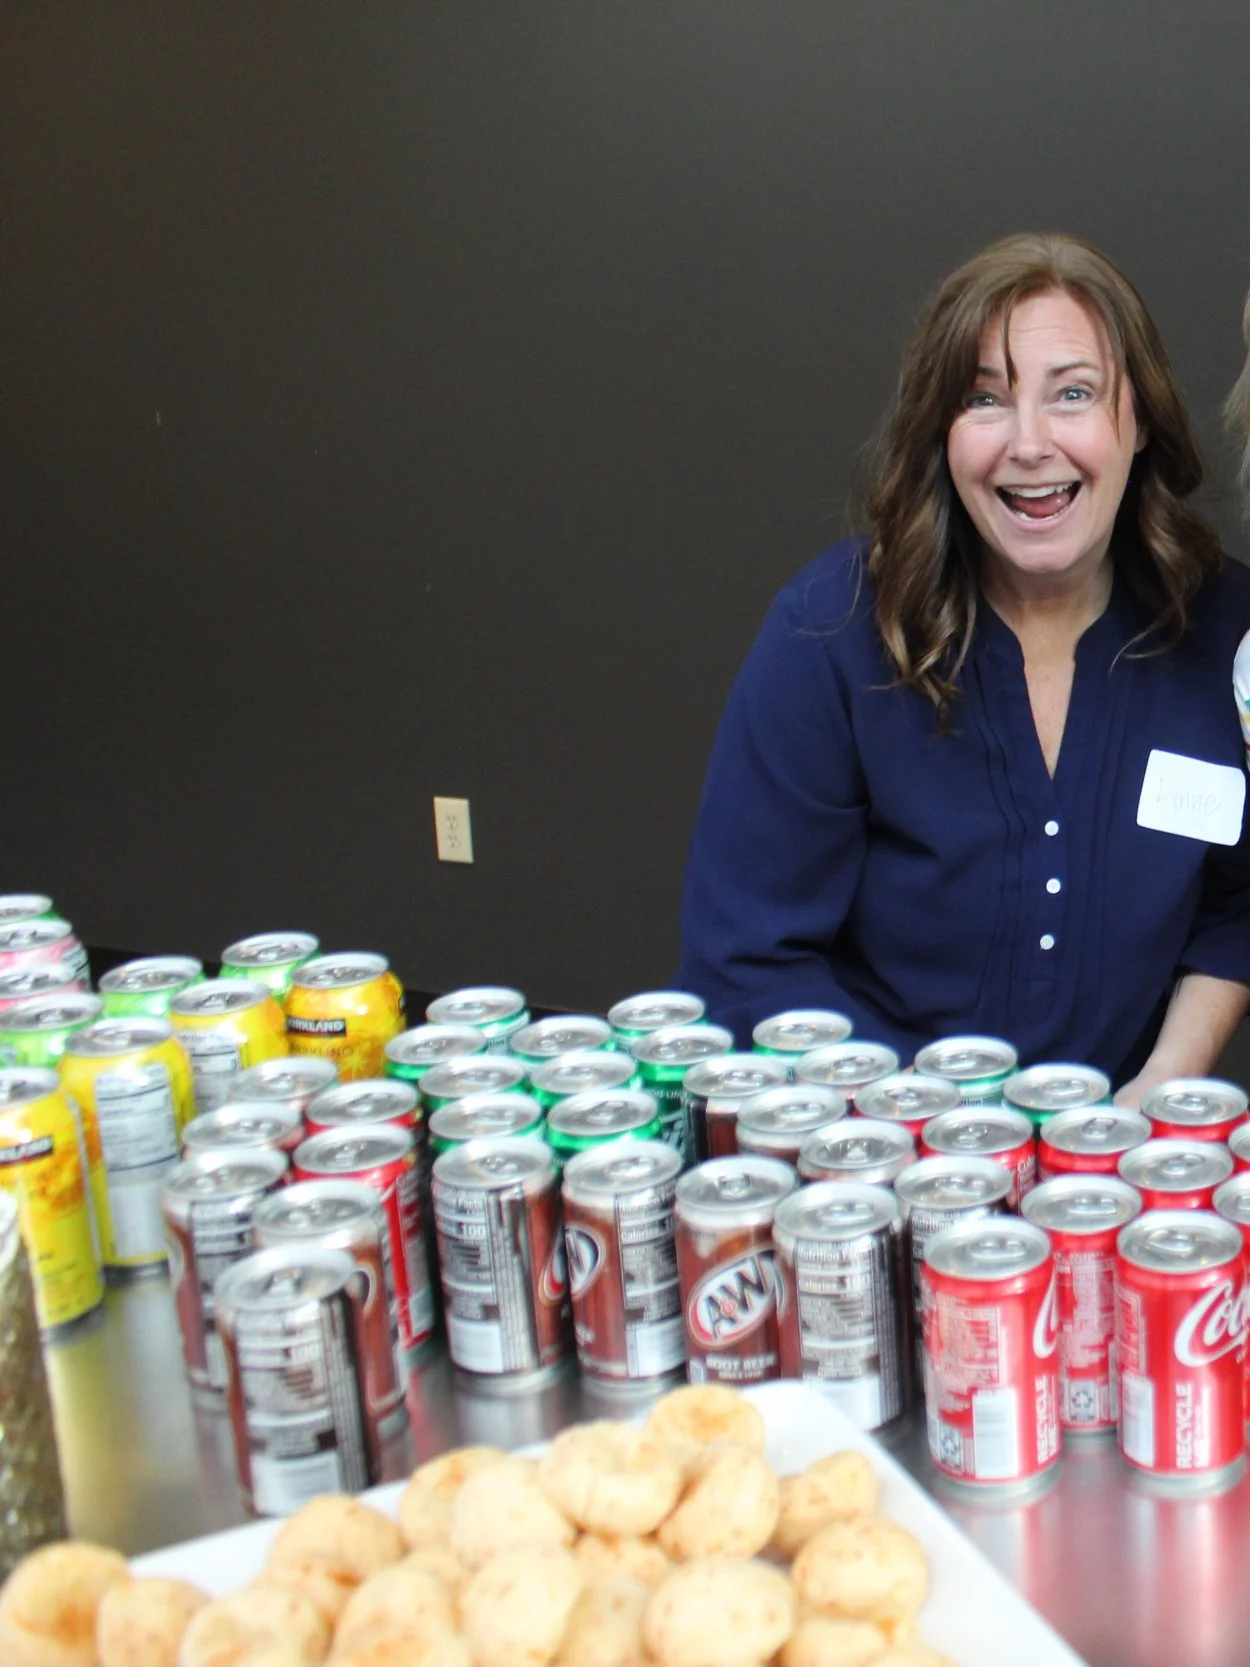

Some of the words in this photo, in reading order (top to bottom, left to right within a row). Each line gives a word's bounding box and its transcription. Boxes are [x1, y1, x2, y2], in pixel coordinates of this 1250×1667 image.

[1155, 777, 1222, 817] Lynne
[462, 1224, 486, 1238] 100
[705, 1254, 768, 1341] A&W
[1034, 1375, 1050, 1465] RECYCLE
[1175, 1382, 1193, 1468] RECYCLE
